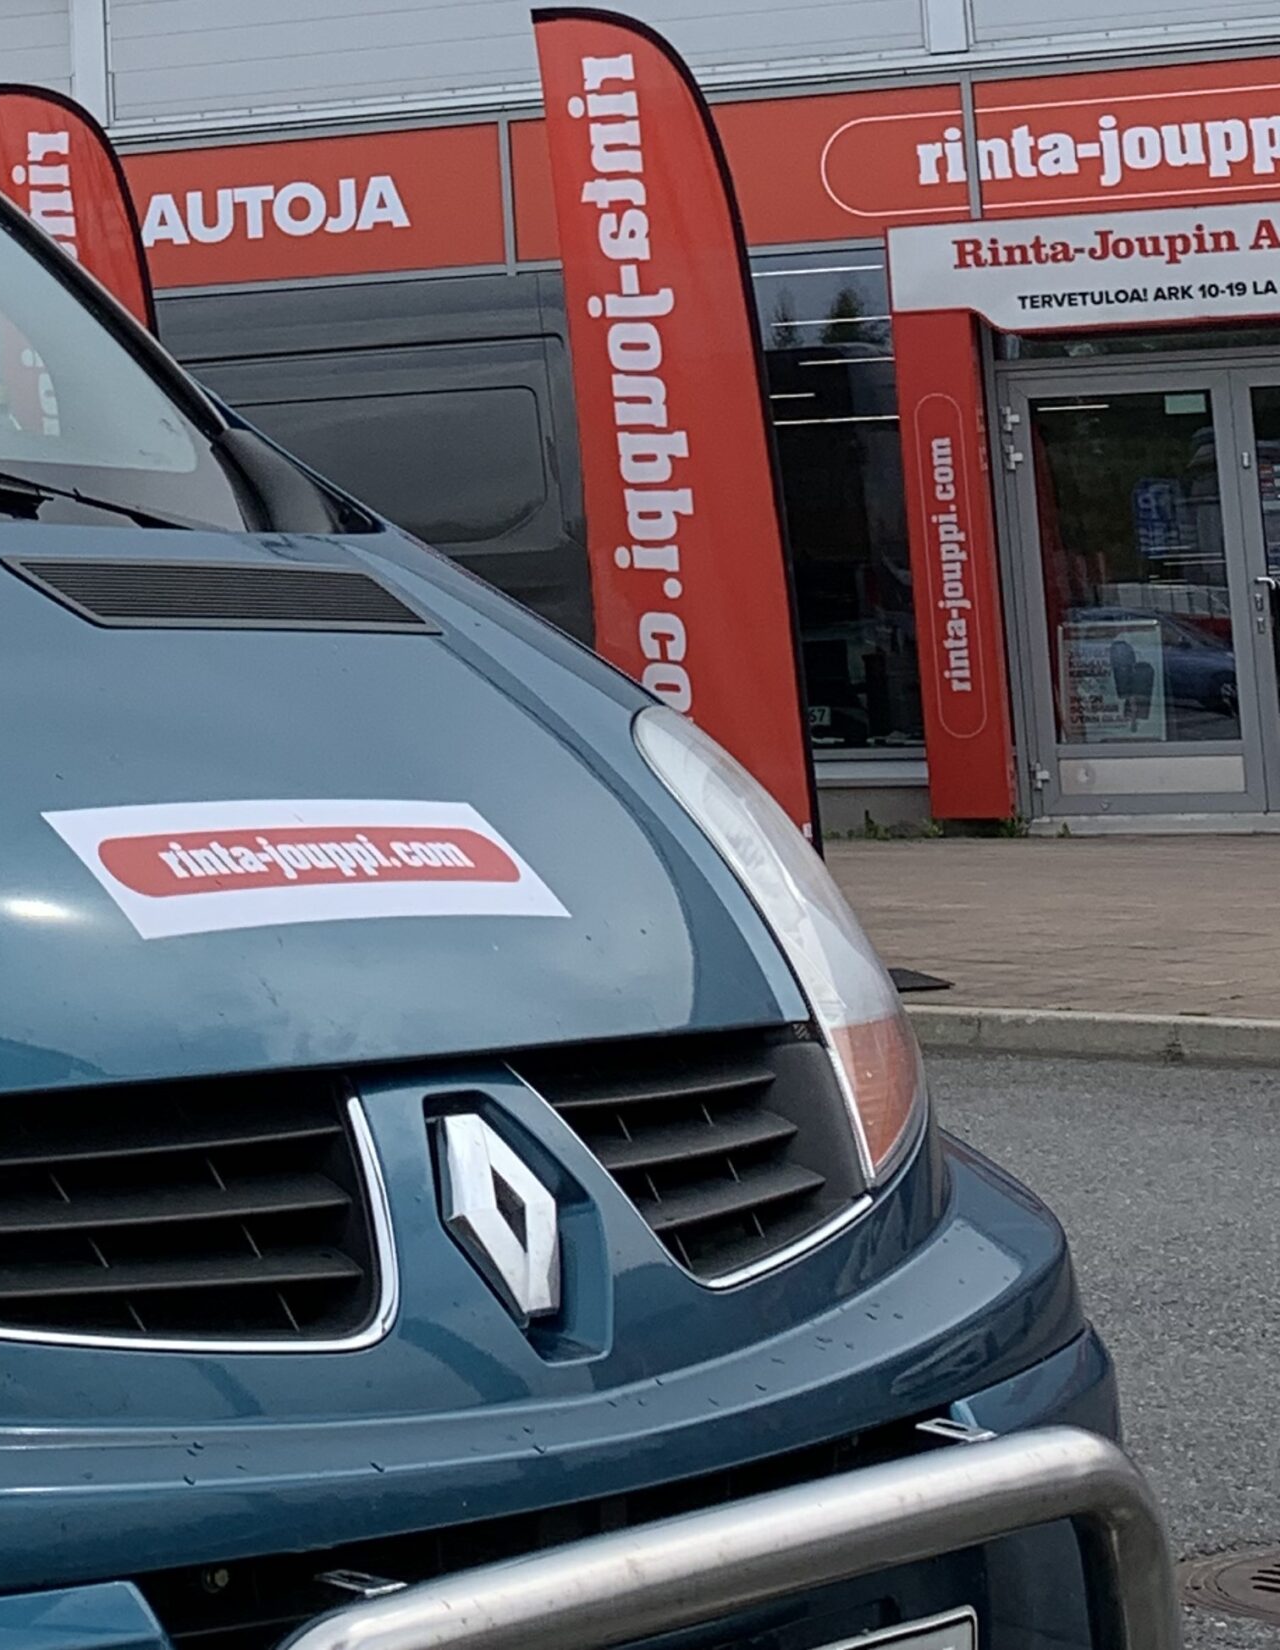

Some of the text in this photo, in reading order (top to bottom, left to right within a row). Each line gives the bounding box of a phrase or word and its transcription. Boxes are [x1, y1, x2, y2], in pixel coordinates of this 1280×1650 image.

[142, 175, 411, 247] AUTOJA
[952, 224, 1239, 270] Rinta-Joupin
[1017, 280, 1278, 310] TERVETULOA! ARK 10-19 LA
[931, 436, 973, 692] rinta-jouppi.com
[158, 833, 475, 880] rinta-jouppi.com
